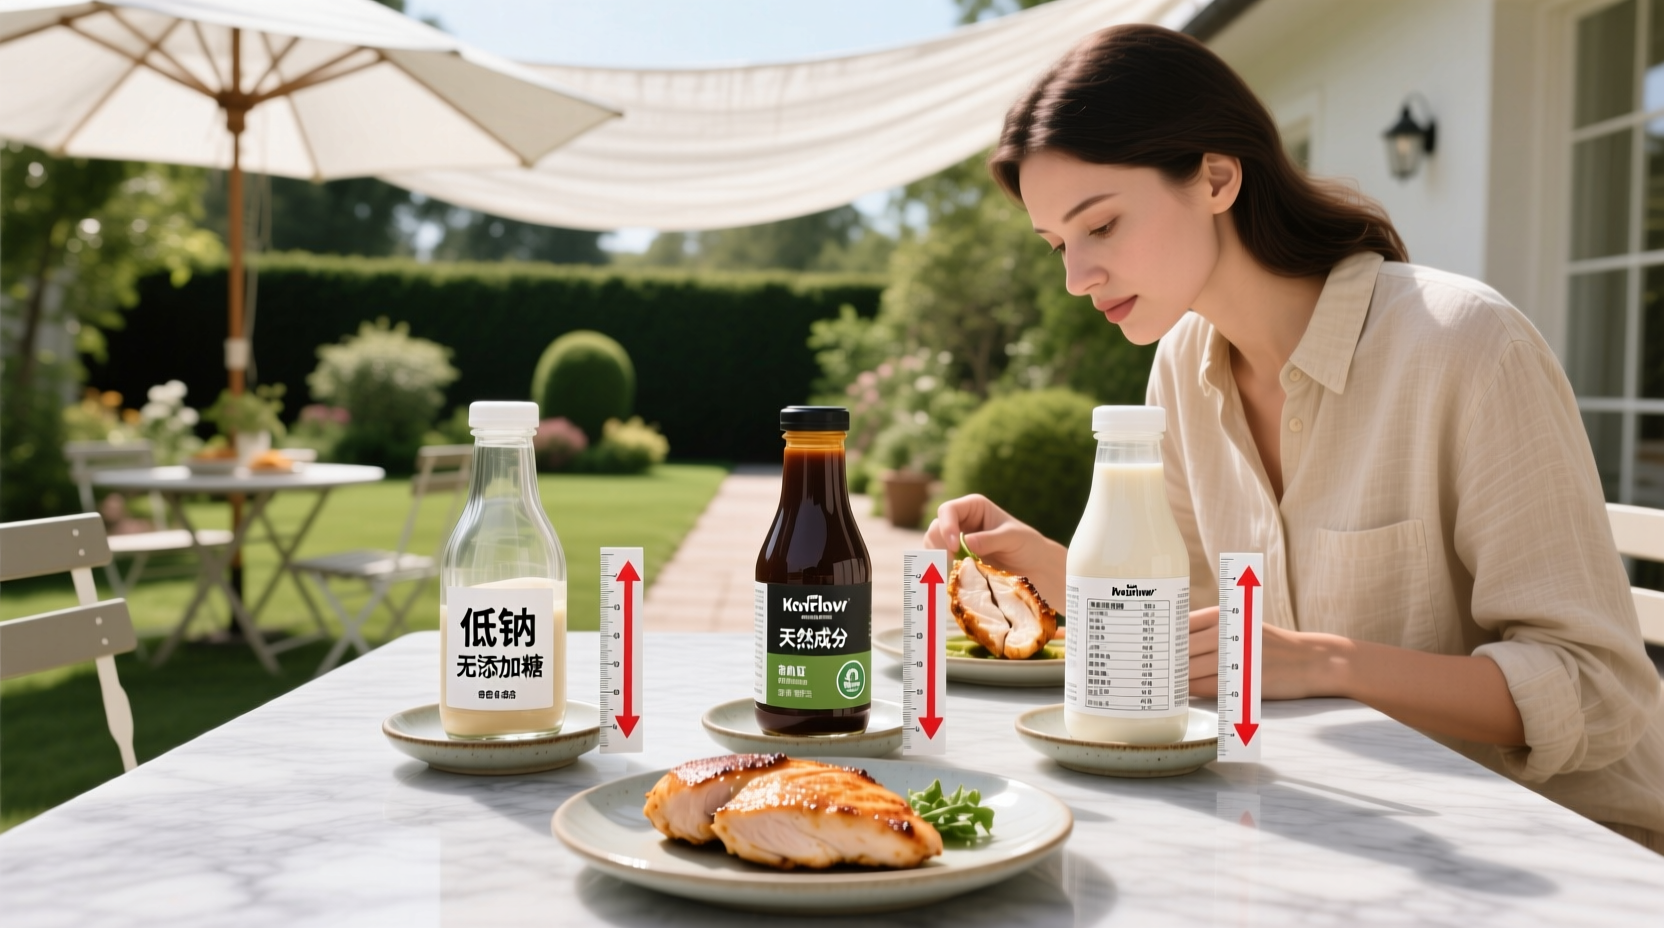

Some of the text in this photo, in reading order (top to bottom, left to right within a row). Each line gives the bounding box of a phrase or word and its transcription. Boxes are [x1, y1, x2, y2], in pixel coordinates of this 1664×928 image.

[460, 607, 536, 648] 低钠
[779, 626, 848, 650] 天然成分
[457, 653, 544, 678] 无添加糖
